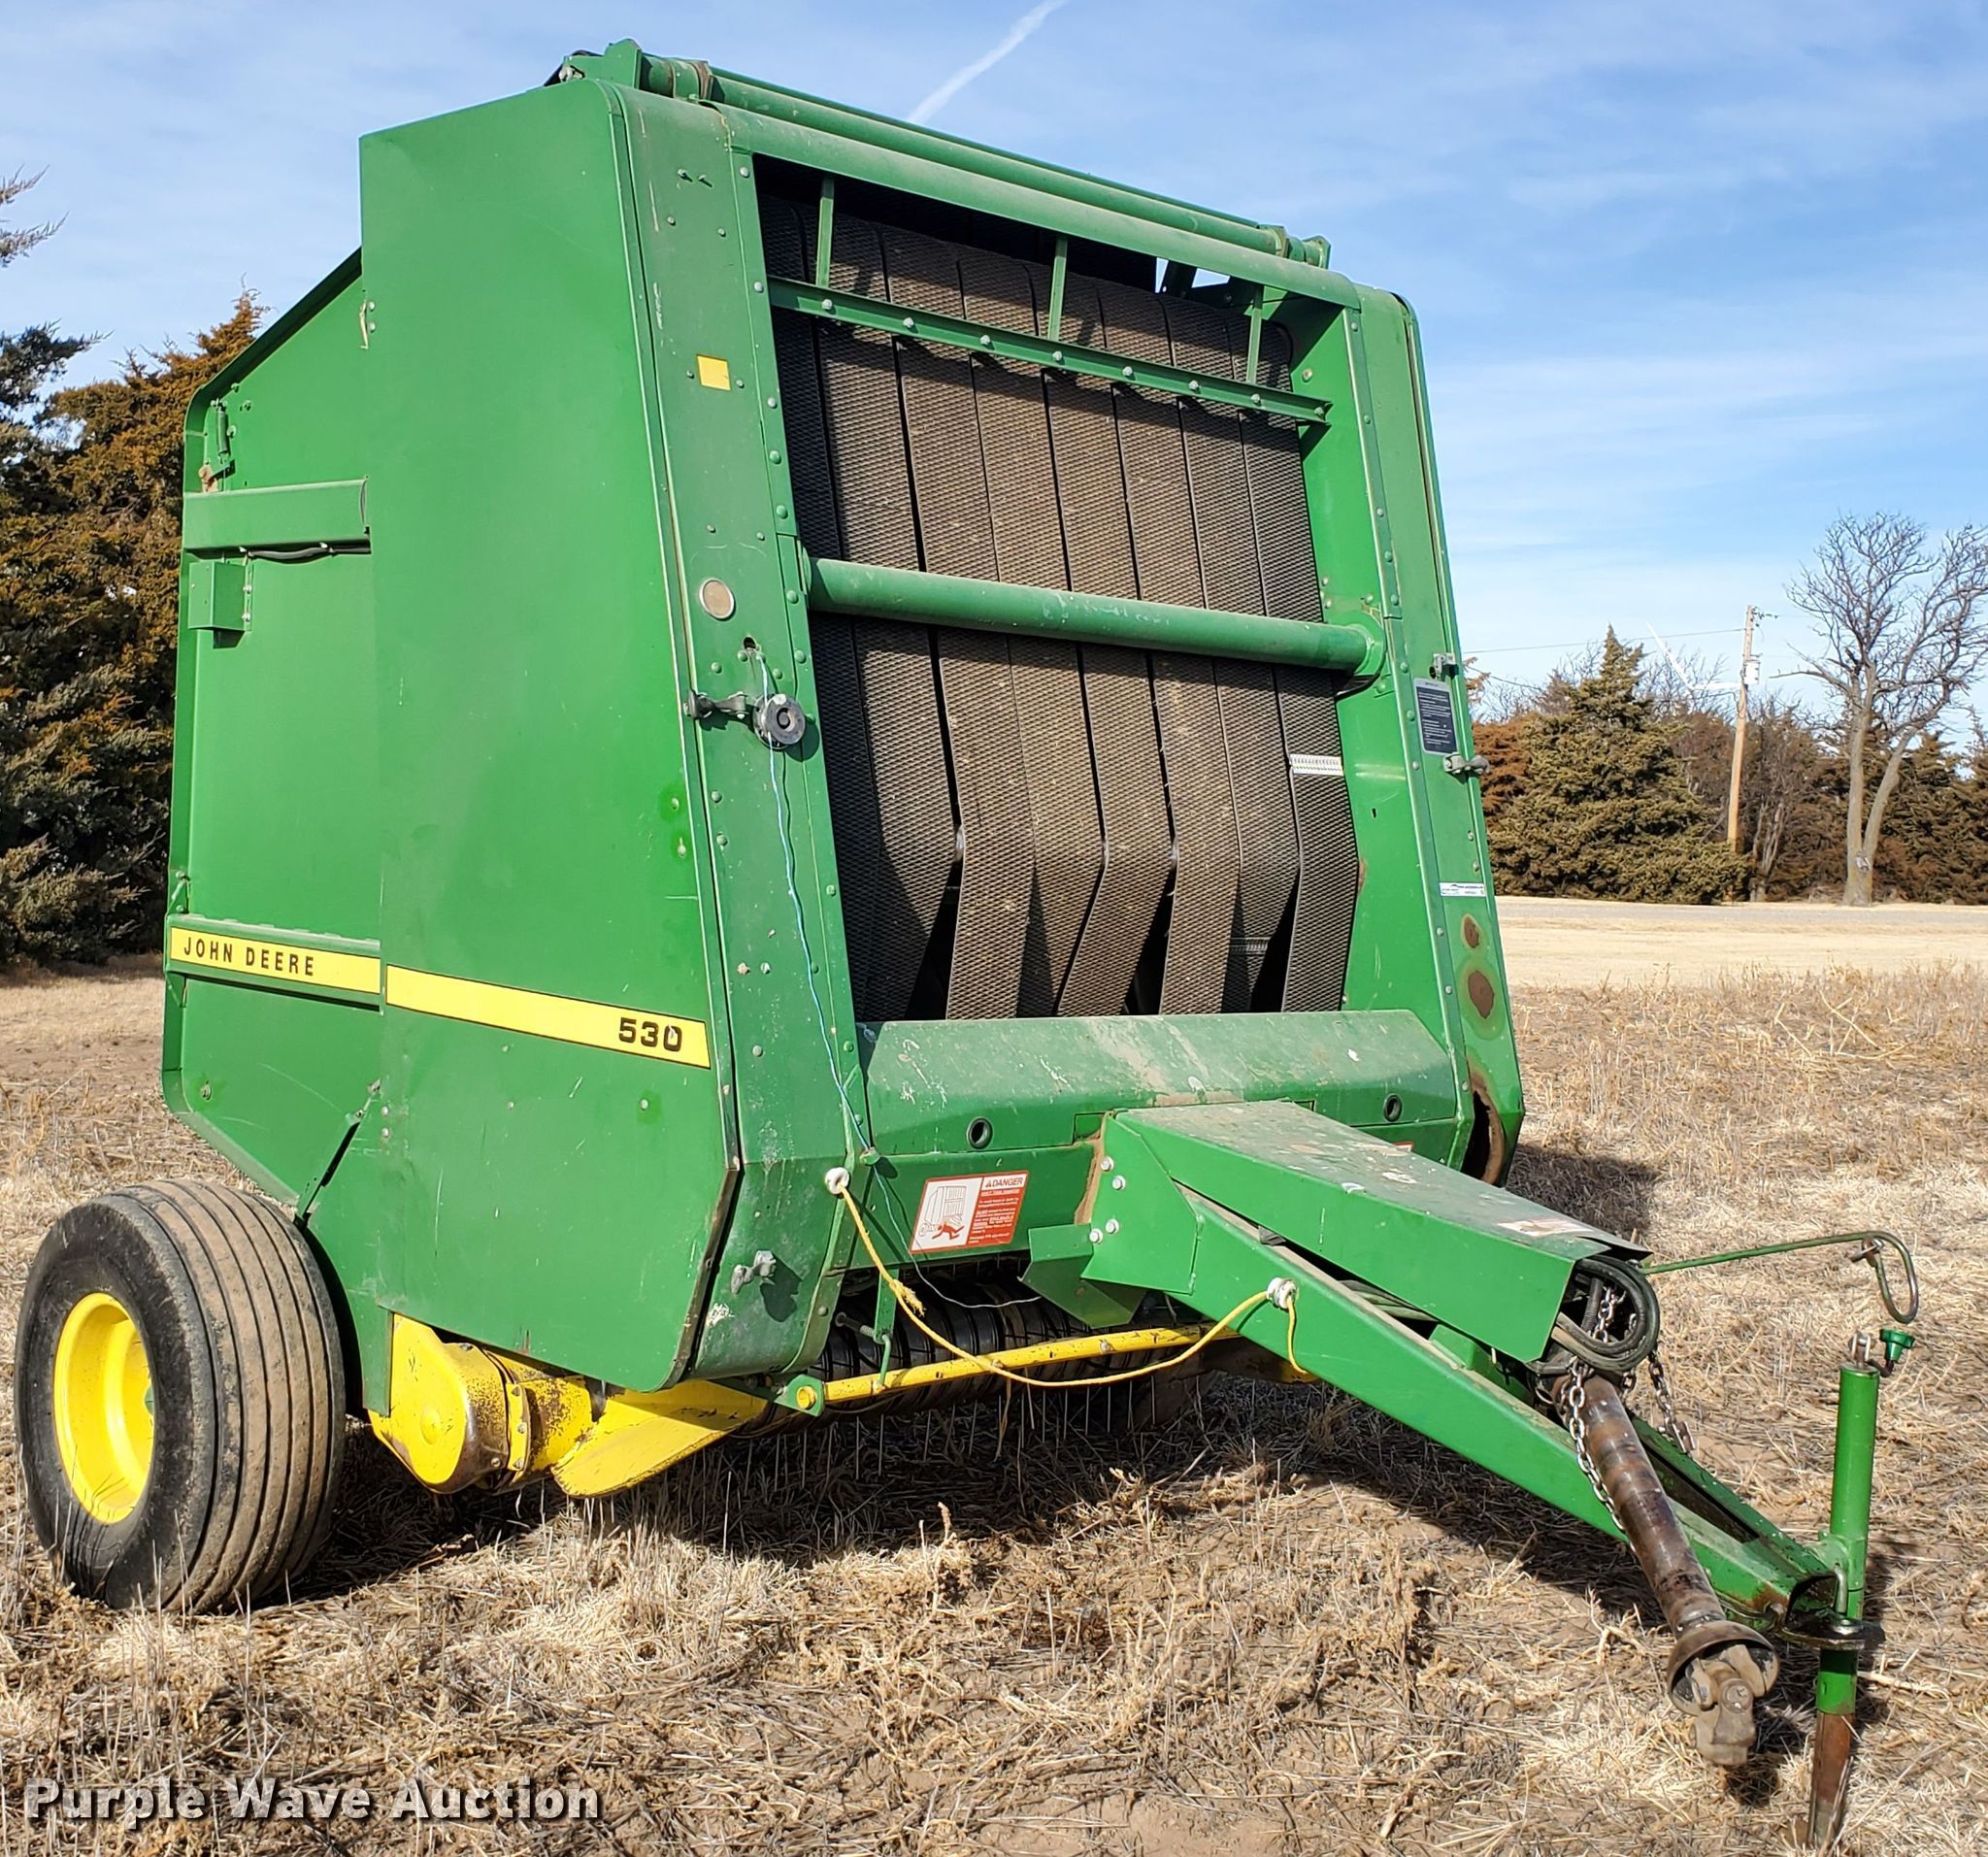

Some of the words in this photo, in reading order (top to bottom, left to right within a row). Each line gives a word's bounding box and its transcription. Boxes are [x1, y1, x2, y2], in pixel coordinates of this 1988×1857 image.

[184, 937, 232, 962] JOHN
[246, 947, 314, 977] DEERE
[618, 1017, 682, 1052] 530
[992, 1177, 1023, 1187] DANGER
